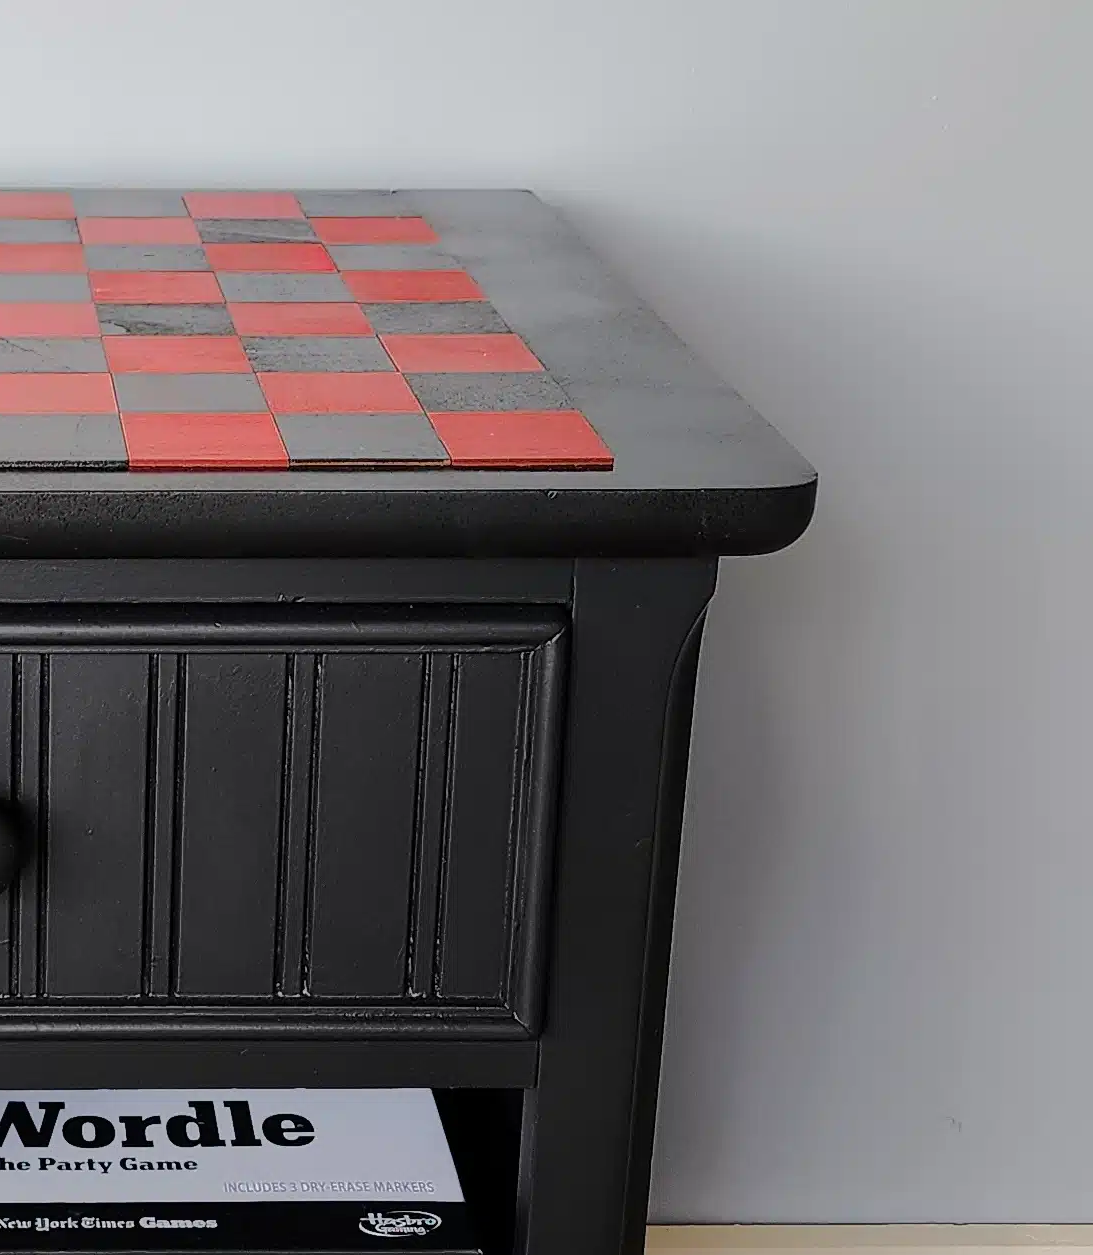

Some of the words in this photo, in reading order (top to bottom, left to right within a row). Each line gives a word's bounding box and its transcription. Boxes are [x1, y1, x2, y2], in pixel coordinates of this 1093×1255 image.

[38, 1157, 113, 1174] Party
[119, 1157, 198, 1171] Game
[224, 1181, 287, 1194] INCLUDES
[290, 1181, 298, 1194] 3
[301, 1181, 370, 1194] DRY-ERASE
[374, 1181, 435, 1194] MARKERS
[35, 1217, 79, 1231] York
[81, 1217, 135, 1230] Times
[139, 1216, 218, 1229] Games
[360, 1212, 437, 1227] Hasbro
